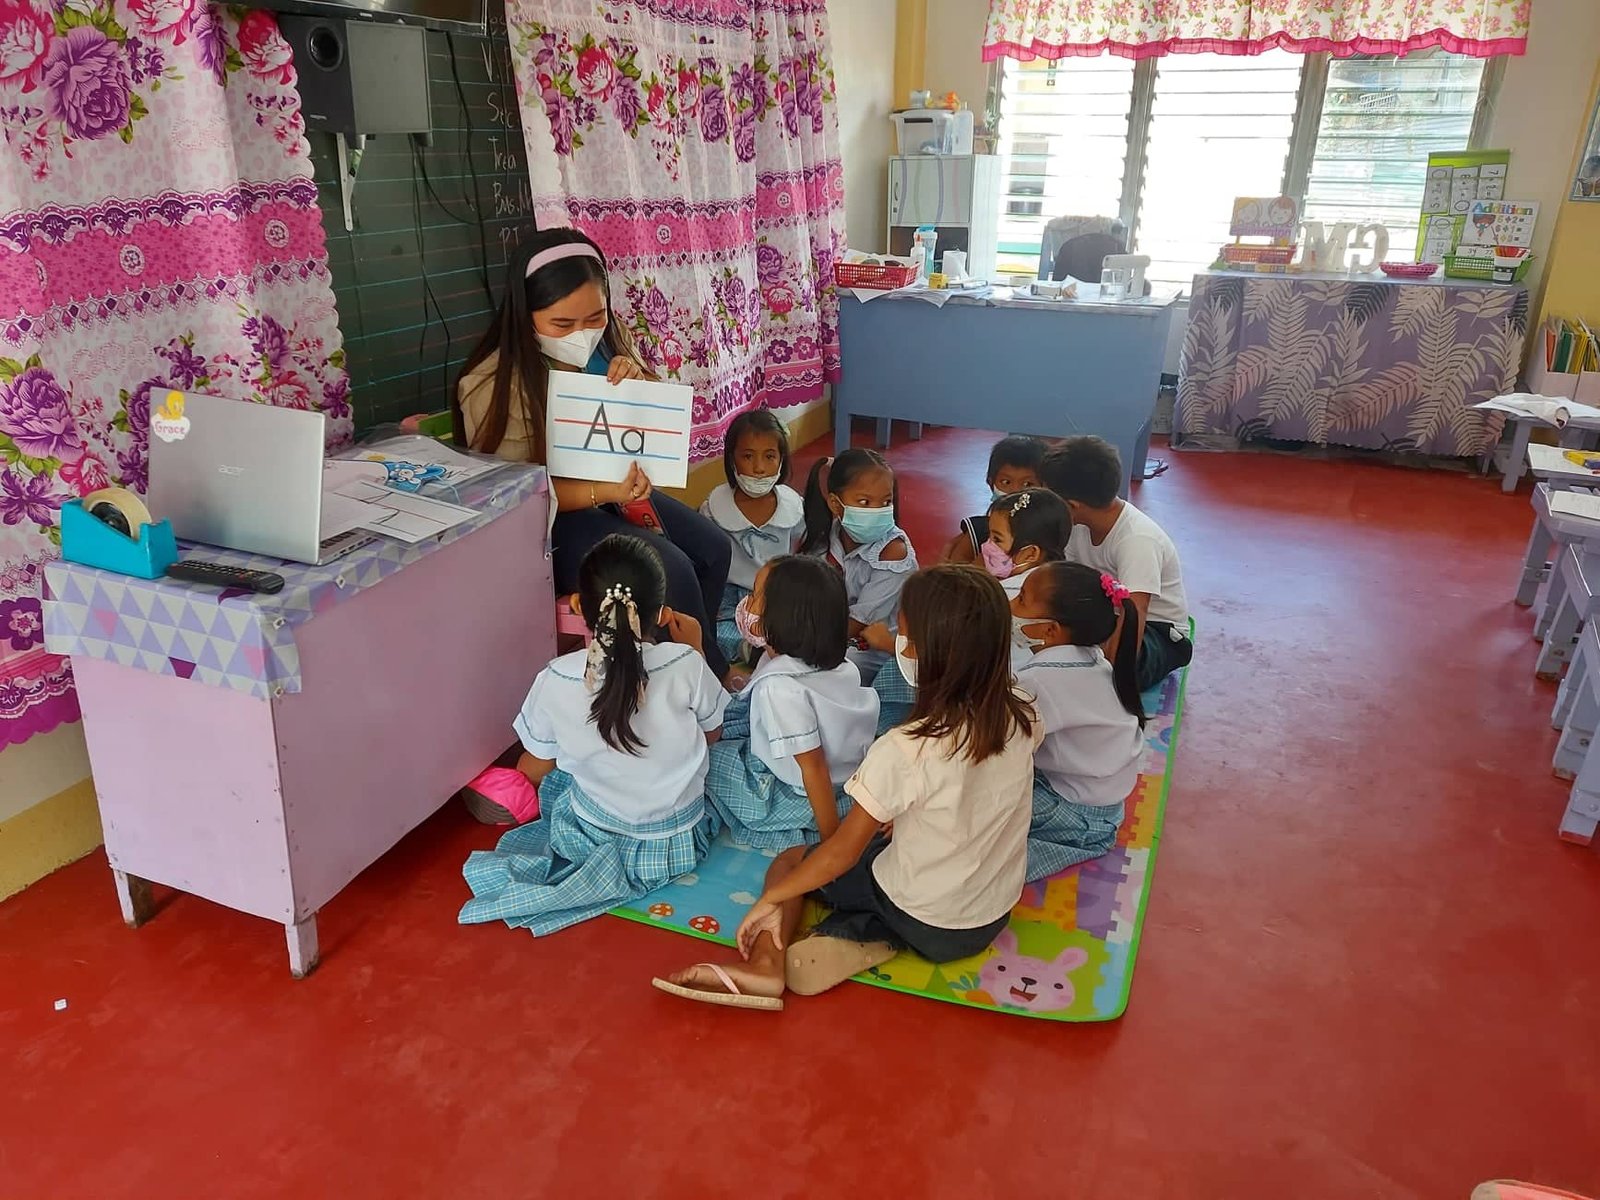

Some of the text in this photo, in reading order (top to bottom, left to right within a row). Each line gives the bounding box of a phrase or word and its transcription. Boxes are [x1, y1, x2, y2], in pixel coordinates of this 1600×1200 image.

[1472, 202, 1533, 215] Addition
[154, 420, 186, 435] Grace
[218, 464, 244, 476] acer
